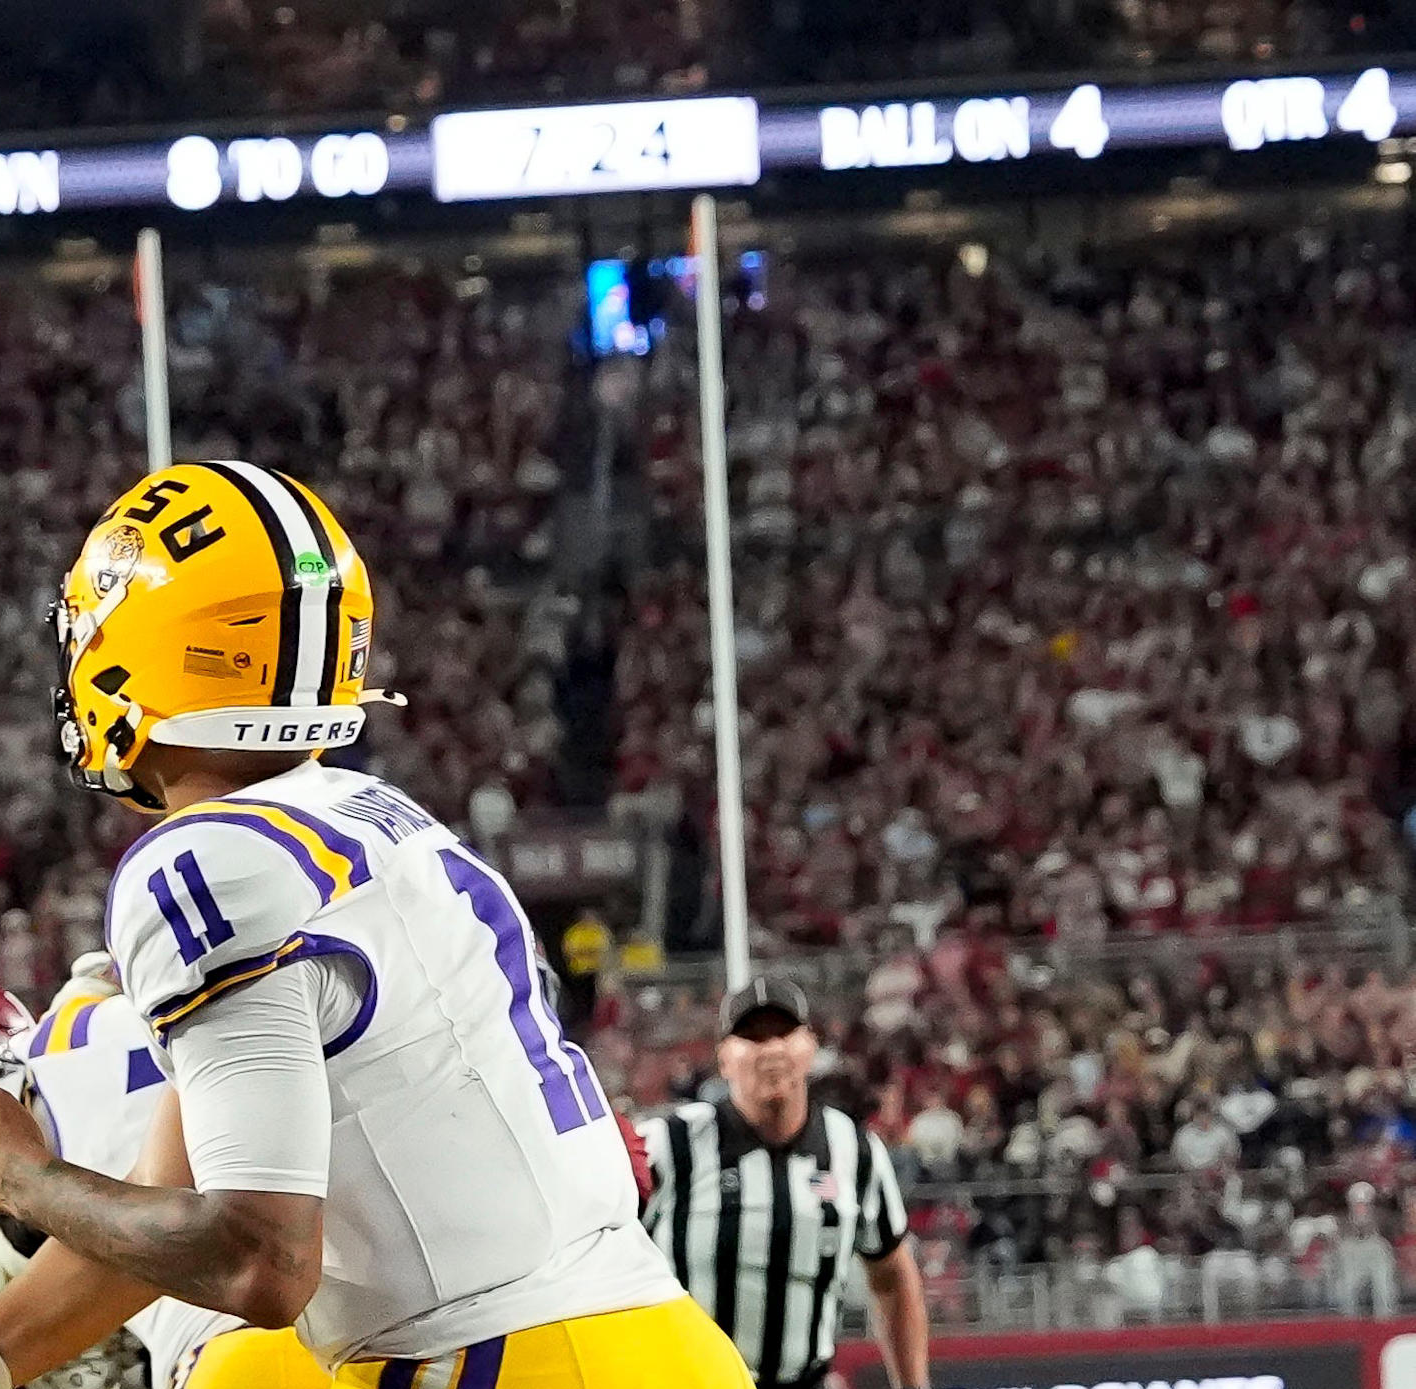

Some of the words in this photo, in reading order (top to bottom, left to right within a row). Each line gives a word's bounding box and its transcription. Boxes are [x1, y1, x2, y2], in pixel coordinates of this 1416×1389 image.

[820, 103, 953, 172] BALL
[953, 96, 1030, 163] ON
[1049, 84, 1110, 160] 4
[1221, 75, 1330, 152] QTR
[1337, 67, 1399, 143] 4
[227, 136, 303, 203] TO
[311, 131, 390, 198] GO
[298, 561, 325, 574] C2P
[233, 719, 359, 744] TIGERS
[147, 849, 236, 967] 11
